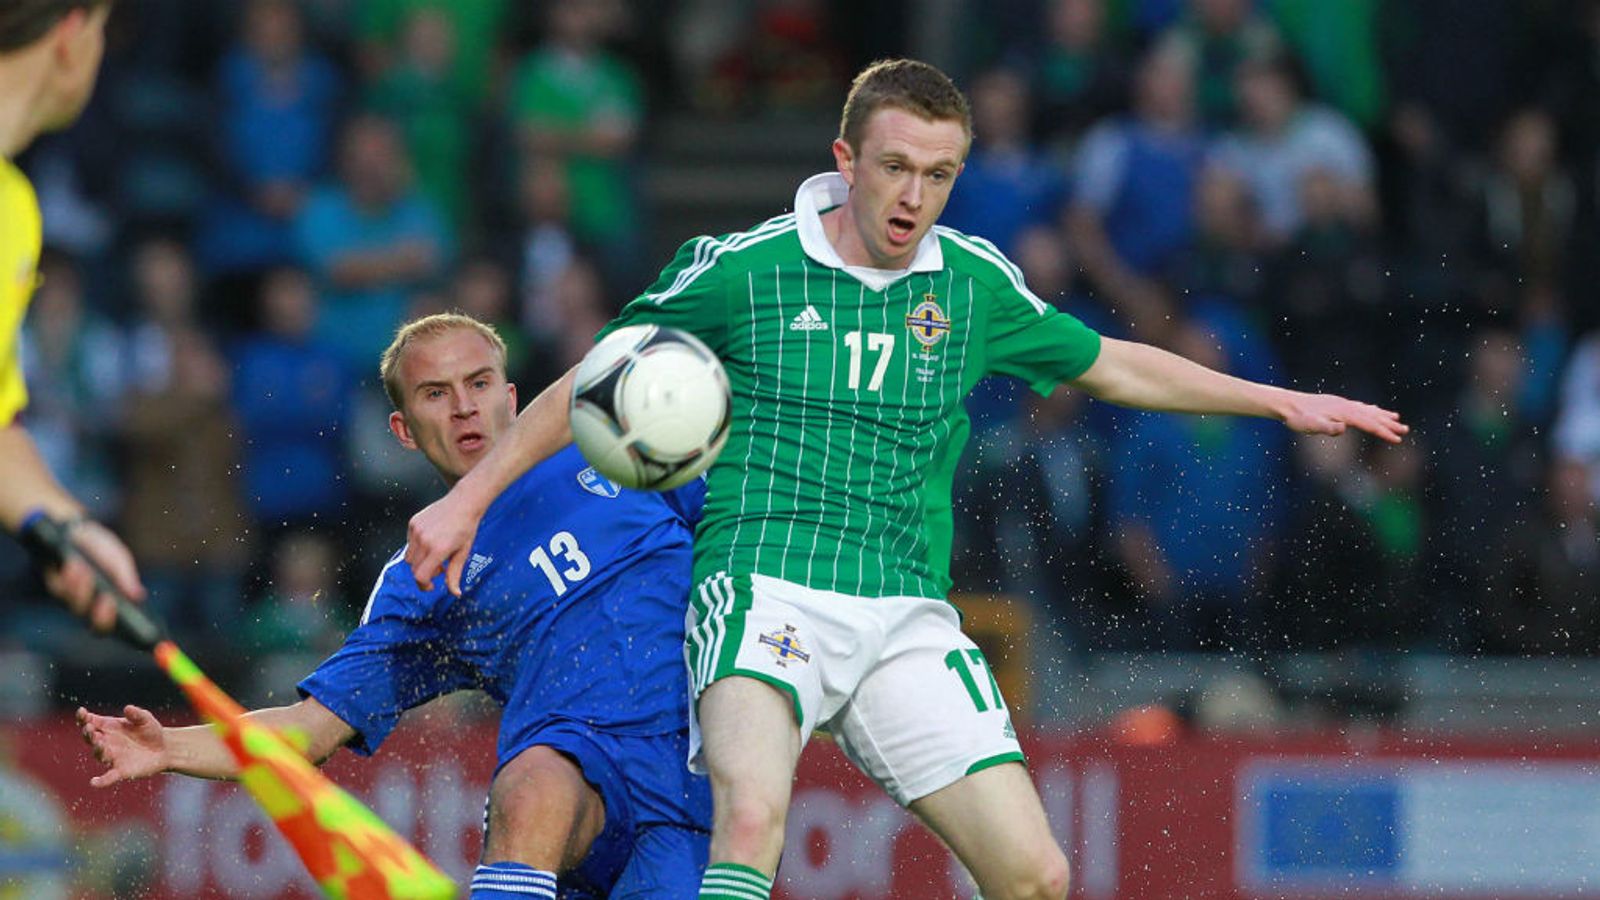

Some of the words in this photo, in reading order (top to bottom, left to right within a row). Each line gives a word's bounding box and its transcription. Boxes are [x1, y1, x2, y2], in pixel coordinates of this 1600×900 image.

[789, 321, 829, 331] adidas
[843, 331, 895, 392] 17
[528, 531, 591, 597] 13
